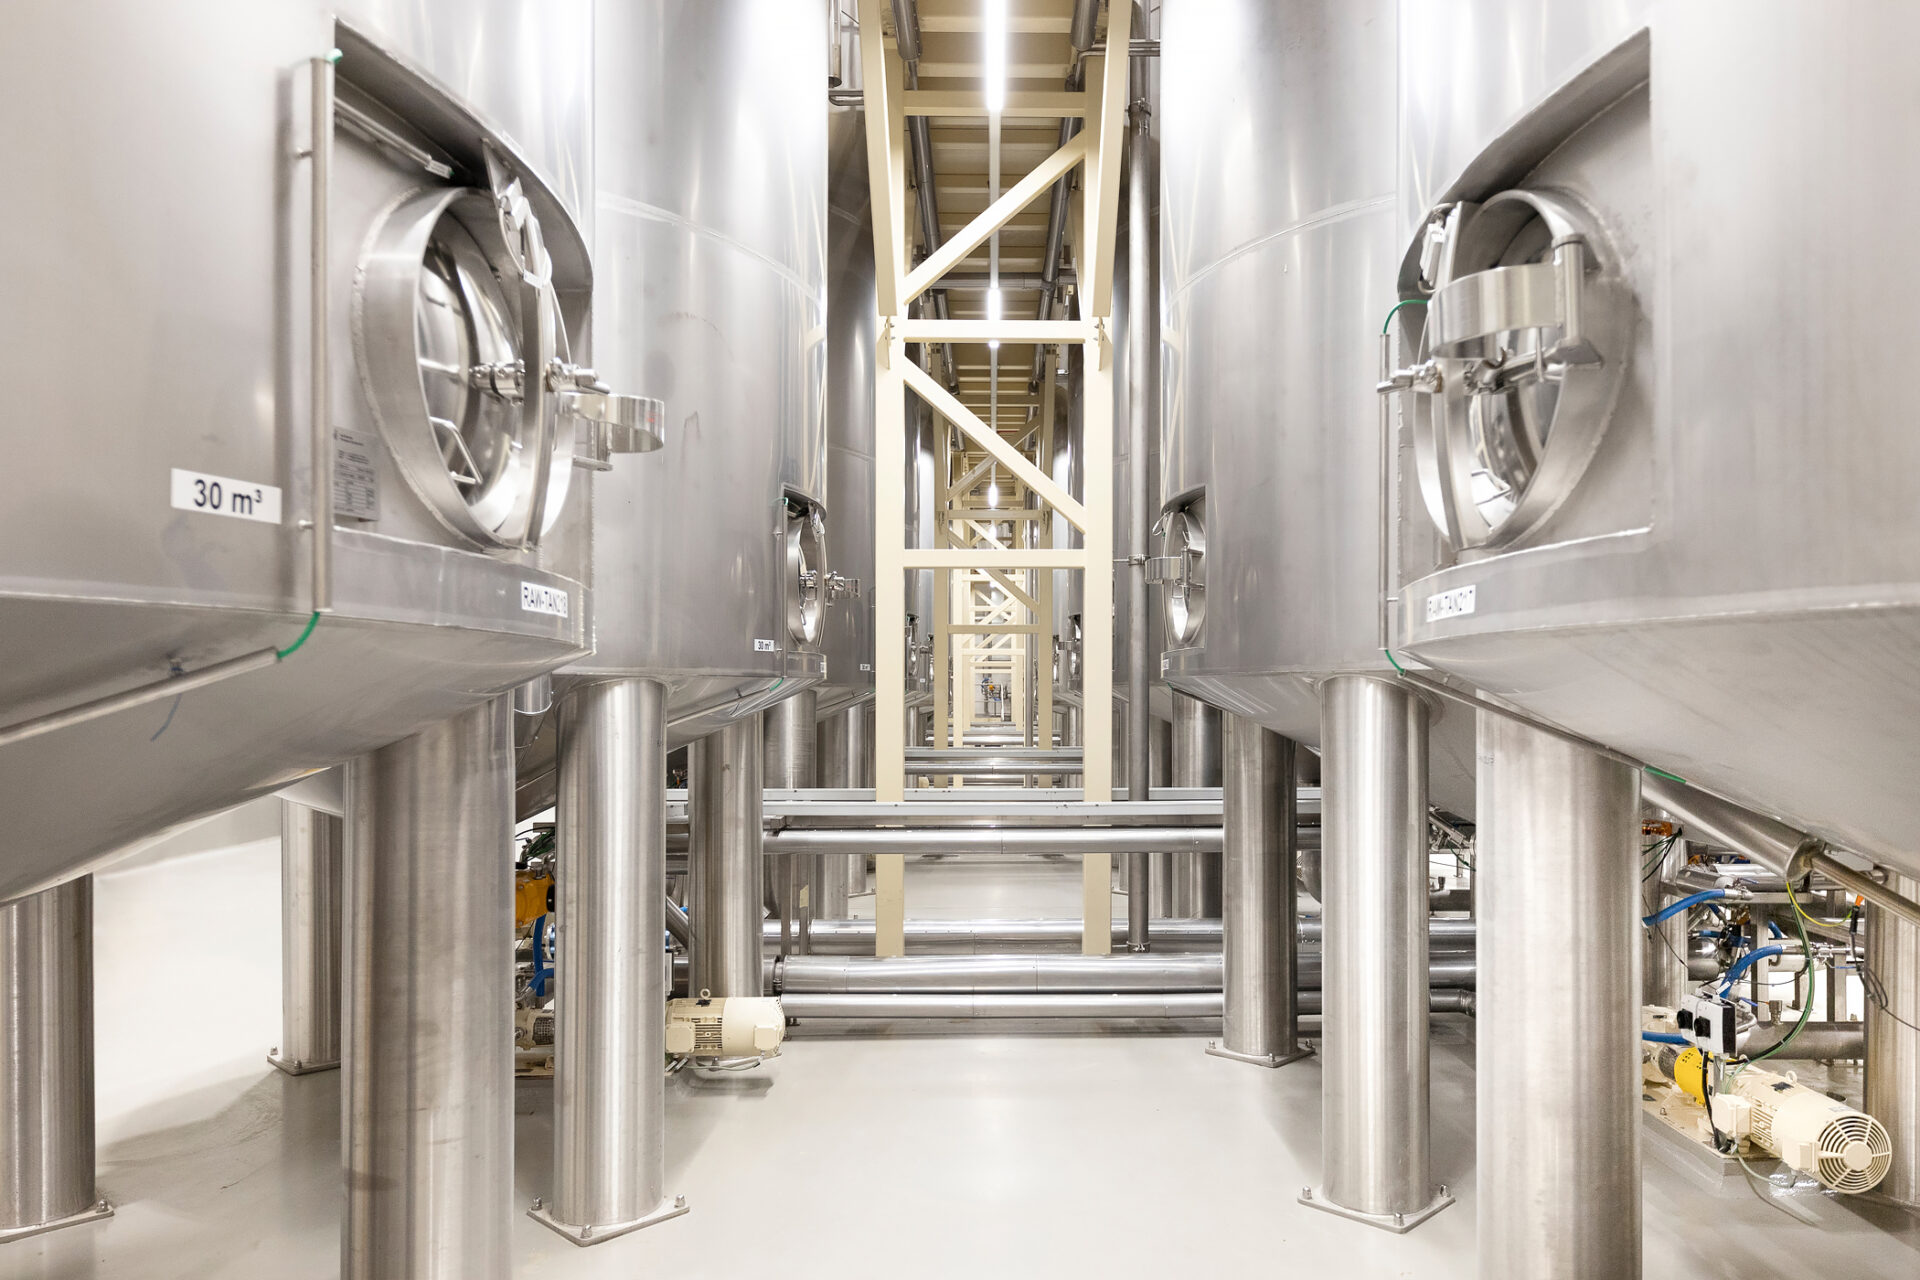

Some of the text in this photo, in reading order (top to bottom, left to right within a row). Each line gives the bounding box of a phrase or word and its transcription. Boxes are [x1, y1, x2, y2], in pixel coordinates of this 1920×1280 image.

[194, 479, 263, 514] 30 m³
[758, 641, 764, 650] 30
